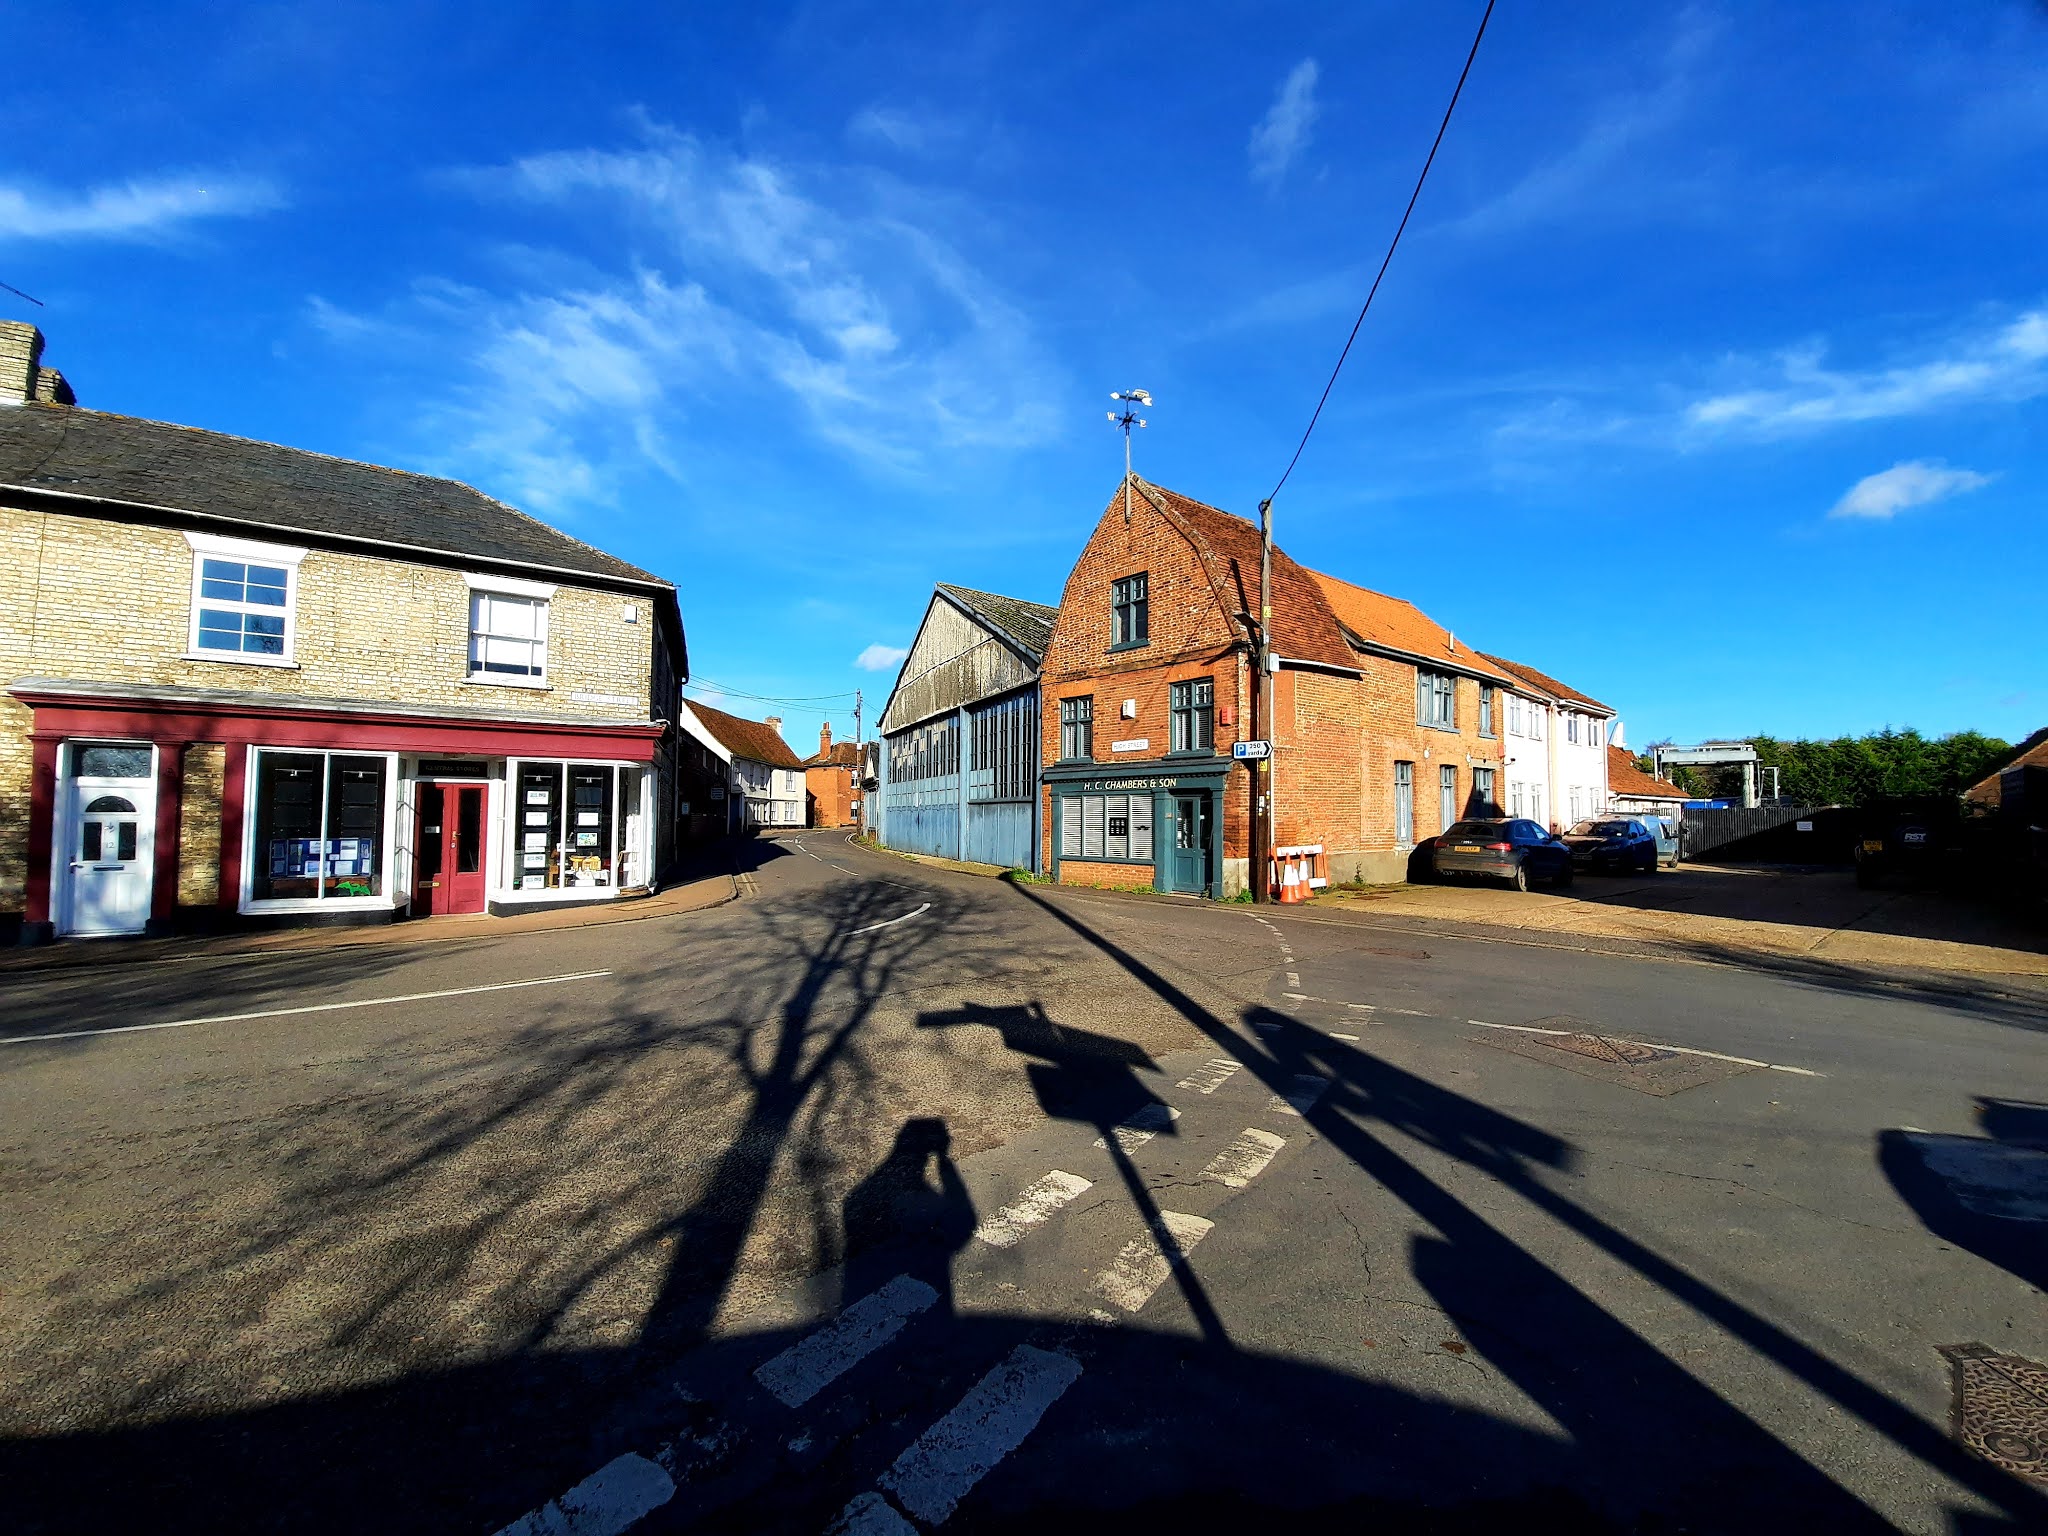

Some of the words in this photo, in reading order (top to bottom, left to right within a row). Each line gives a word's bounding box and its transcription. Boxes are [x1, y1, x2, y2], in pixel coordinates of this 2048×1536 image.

[1107, 411, 1115, 421] W
[1127, 741, 1146, 749] STREET
[1237, 745, 1245, 755] P
[1084, 782, 1092, 790] H.
[1095, 781, 1103, 790] C.
[1105, 779, 1148, 790] CHAMBERS
[1150, 779, 1157, 788] &
[1159, 778, 1177, 788] SON
